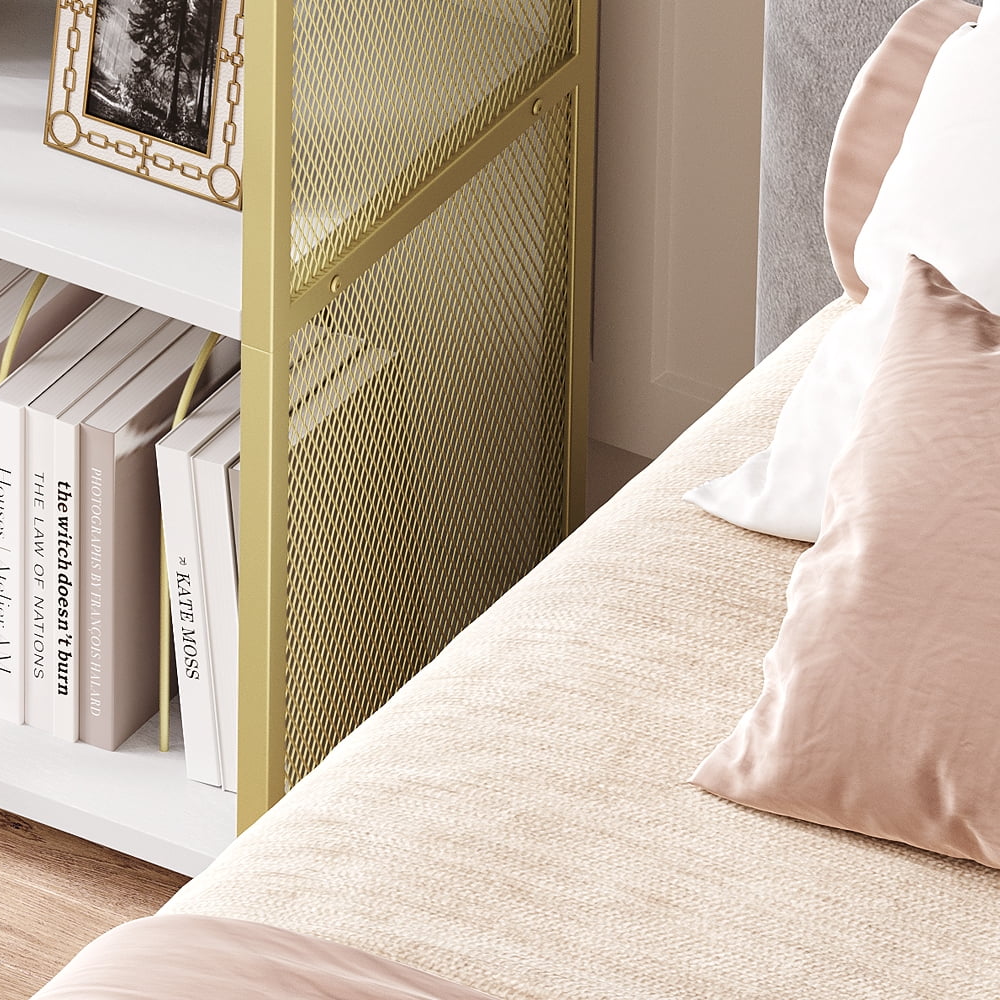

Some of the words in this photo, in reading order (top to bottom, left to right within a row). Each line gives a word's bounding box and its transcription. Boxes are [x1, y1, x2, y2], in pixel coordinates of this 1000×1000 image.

[34, 472, 44, 510] THE
[34, 517, 44, 558] LAW
[90, 467, 102, 570] PHOTOGRAPHS
[34, 564, 44, 590] OF
[90, 573, 102, 587] BY
[176, 571, 194, 622] KATE
[34, 596, 44, 679] NATIONS
[88, 592, 102, 659] FRANÇOIS
[58, 650, 72, 696] burn
[181, 626, 200, 680] MOSS
[90, 662, 101, 717] HALARD
